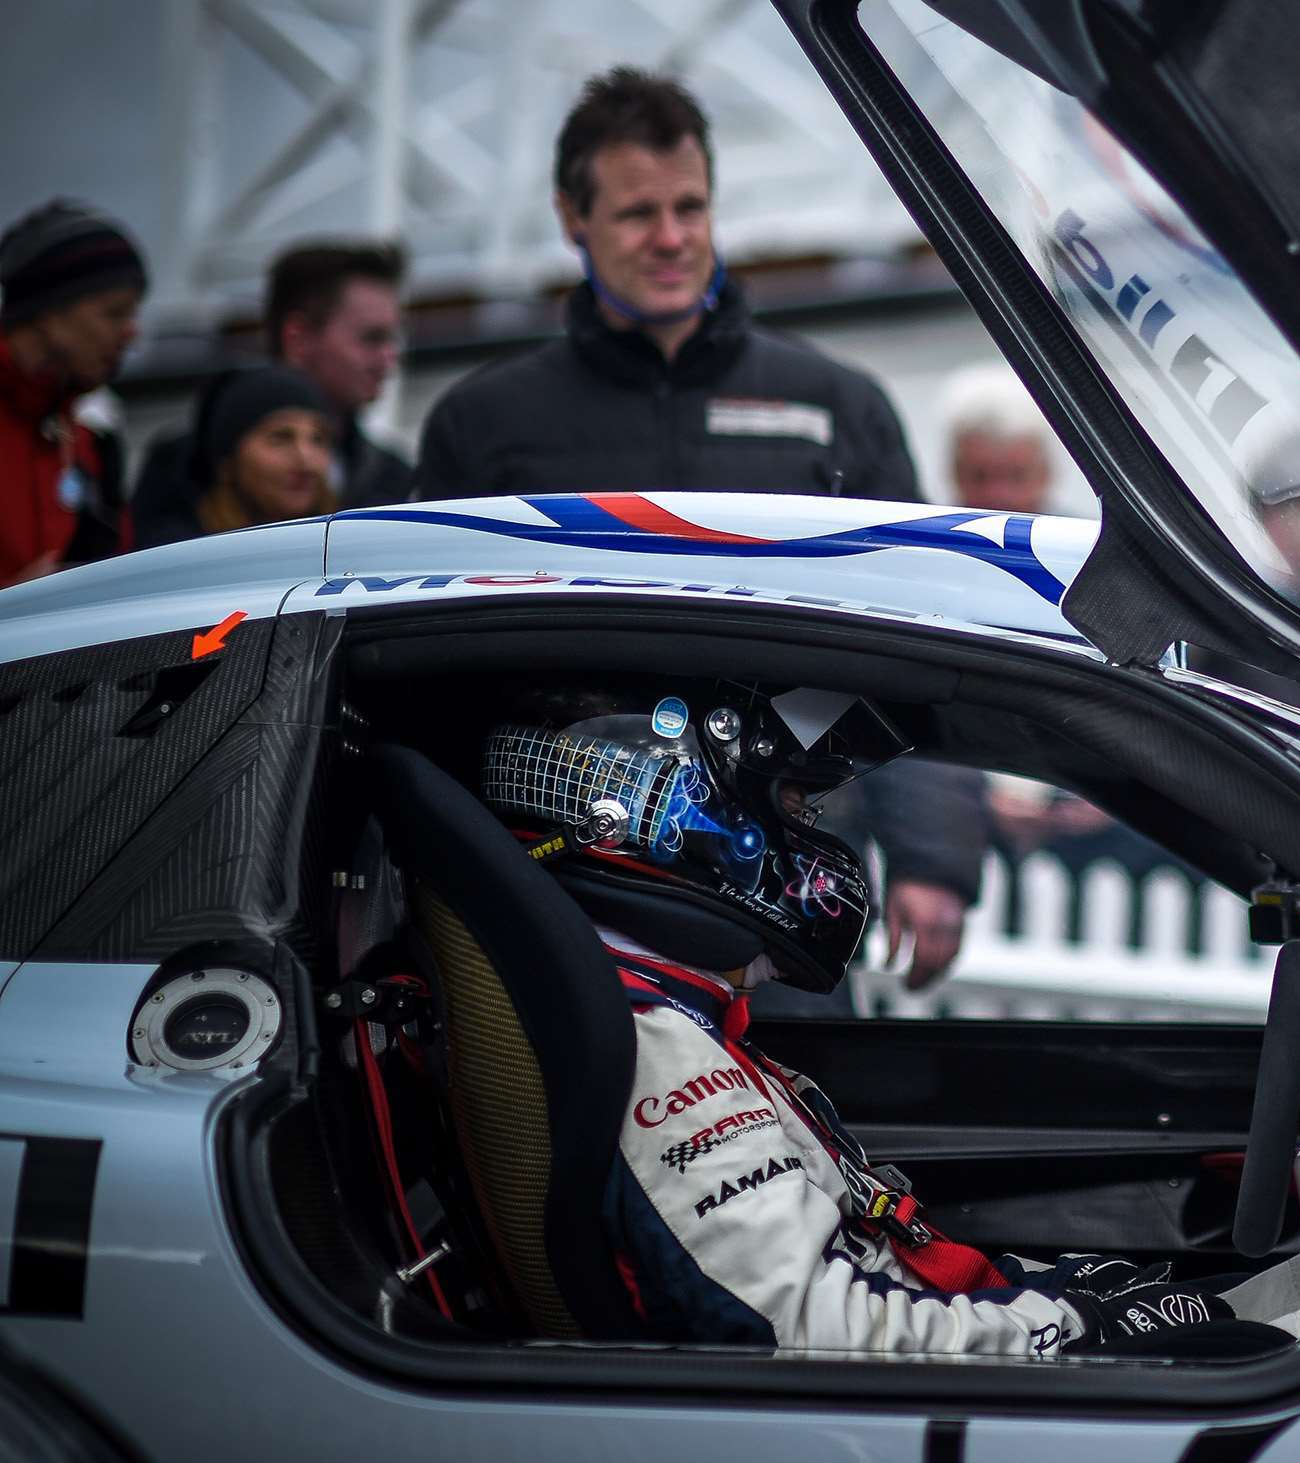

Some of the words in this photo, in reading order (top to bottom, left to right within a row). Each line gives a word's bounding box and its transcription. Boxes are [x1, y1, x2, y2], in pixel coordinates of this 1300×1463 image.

[633, 1067, 749, 1129] Canon
[690, 1108, 775, 1148] PARR
[694, 1157, 805, 1219] RAMAIR
